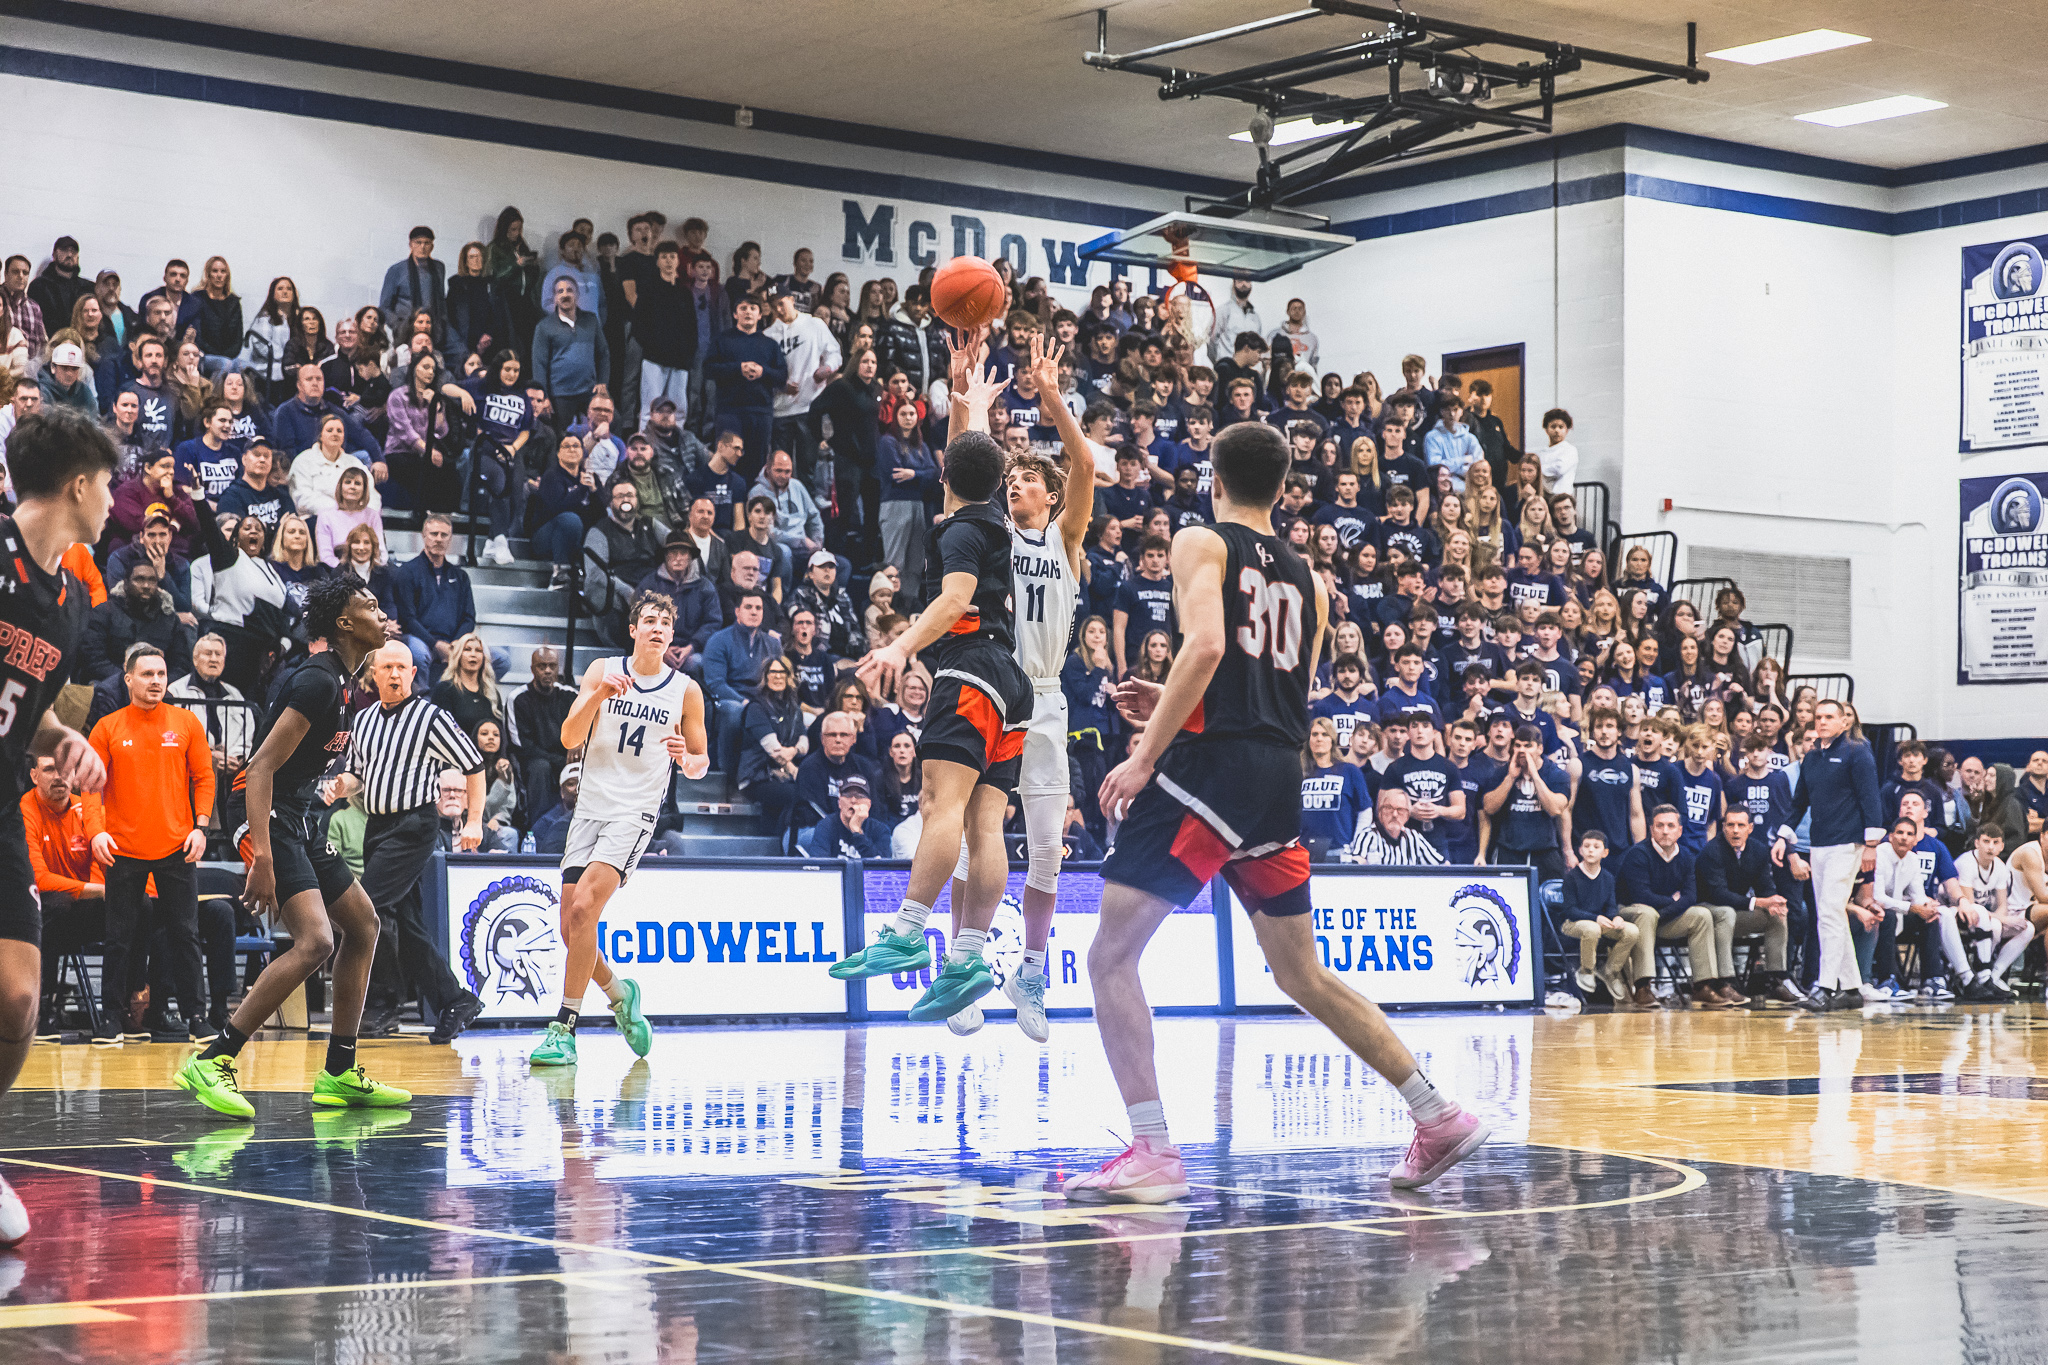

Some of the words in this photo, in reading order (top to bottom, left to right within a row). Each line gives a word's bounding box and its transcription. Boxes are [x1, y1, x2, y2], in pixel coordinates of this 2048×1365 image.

[1972, 297, 2048, 322] McDOWE
[1984, 313, 2048, 337] TROJANS
[488, 406, 520, 426] OUT
[1013, 412, 1040, 424] BLU
[204, 464, 237, 479] BLUE
[1969, 534, 2048, 554] McDOWEL
[1980, 550, 2047, 570] TROJANS
[1026, 582, 1046, 623] 11
[1512, 585, 1547, 600] BLUE
[1237, 565, 1304, 673] 30
[607, 697, 670, 726] TROJANS
[617, 721, 647, 757] 14
[1302, 780, 1340, 792] BLUE
[1403, 769, 1447, 784] REVENGE
[1411, 780, 1440, 791] TOUR
[1303, 794, 1335, 809] OUT
[1746, 786, 1770, 800] BIG
[1342, 908, 1367, 930] OF
[1375, 908, 1417, 930] THE
[597, 920, 837, 964] cDOWELL
